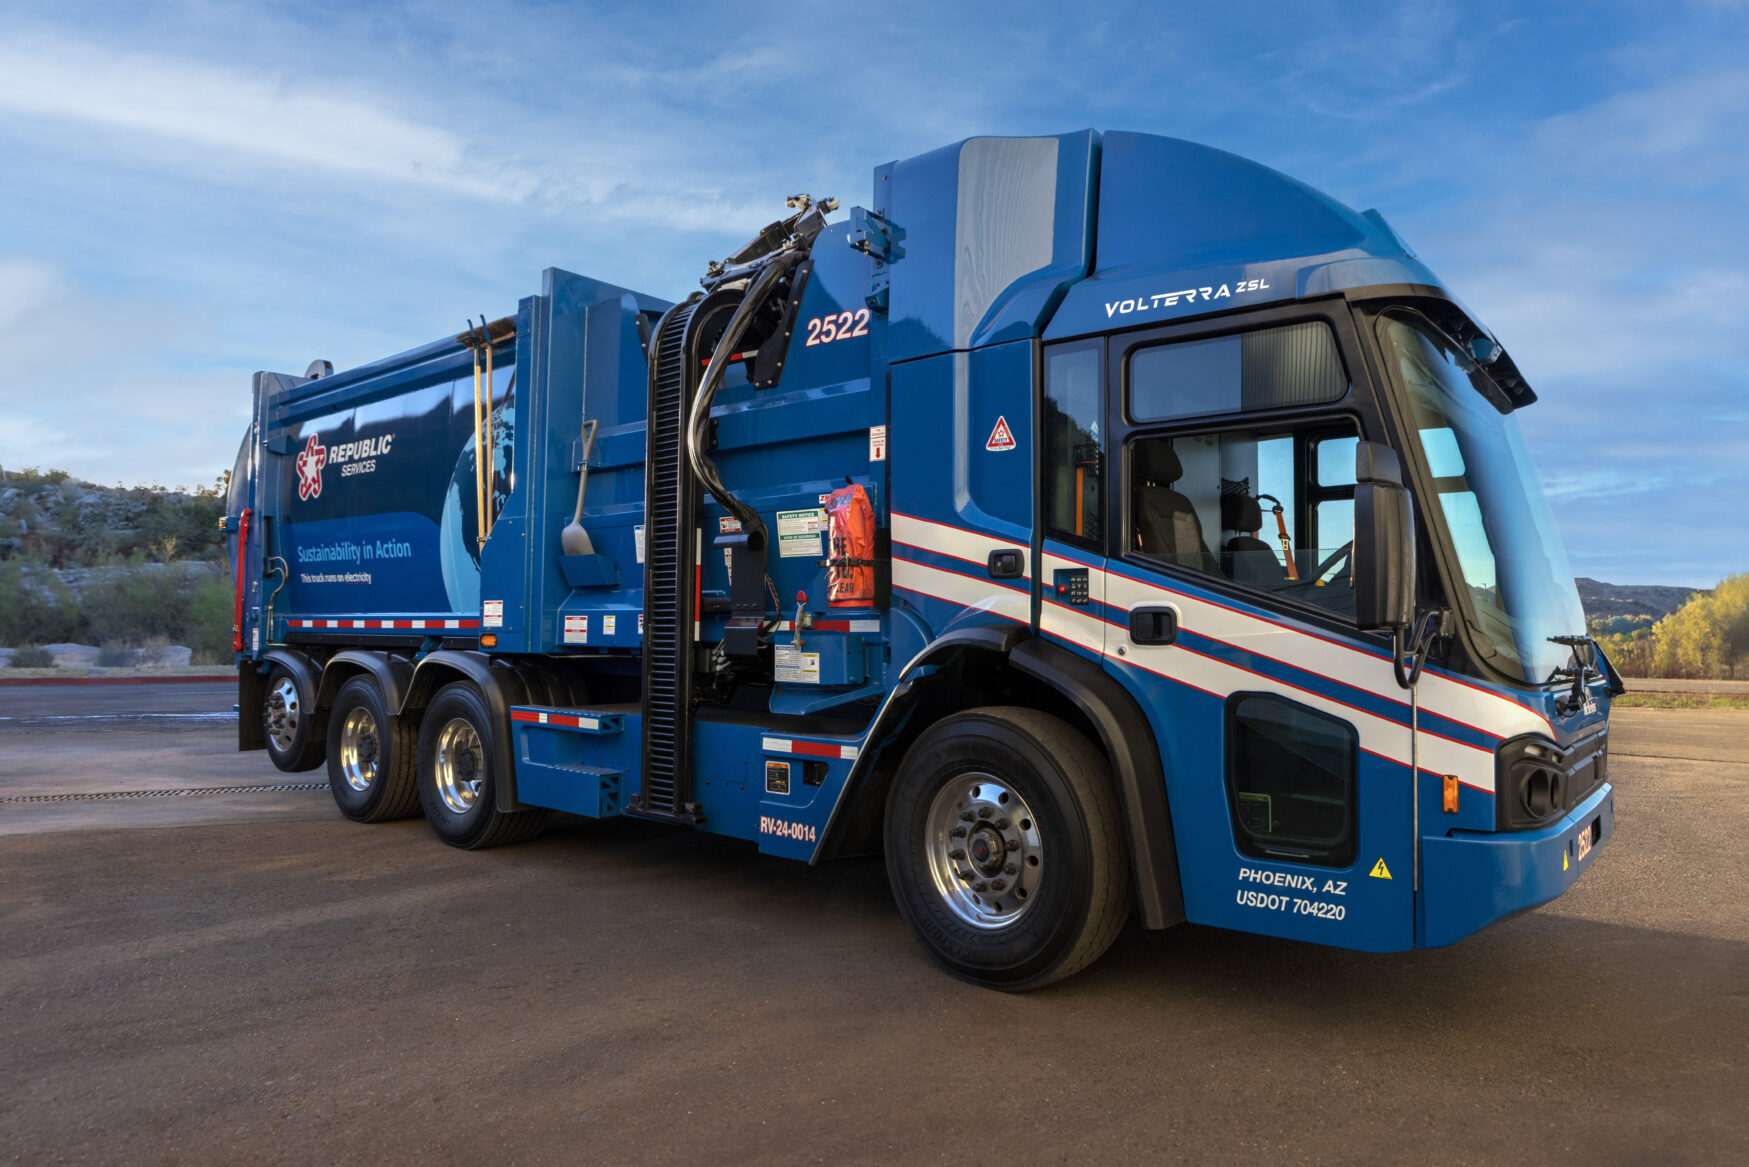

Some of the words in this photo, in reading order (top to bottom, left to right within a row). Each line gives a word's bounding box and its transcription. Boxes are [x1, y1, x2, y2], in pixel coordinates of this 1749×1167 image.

[1105, 284, 1231, 319] VOLTERRA
[1236, 279, 1270, 293] ZSL
[805, 307, 871, 347] 2522
[328, 434, 392, 464] REPUBLIC
[341, 459, 376, 477] SERVICES
[298, 542, 361, 565] Sustainability
[362, 540, 373, 559] in
[375, 538, 412, 559] Action
[300, 573, 312, 583] This
[312, 572, 324, 583] truck
[325, 574, 337, 583] runs
[337, 574, 344, 582] on
[345, 571, 372, 584] electricity
[760, 816, 816, 843] RV-24-0014
[1238, 868, 1317, 893] PHOENIX,
[1322, 880, 1348, 895] AZ
[1236, 889, 1289, 911] USDOT
[1292, 899, 1346, 920] 704220
